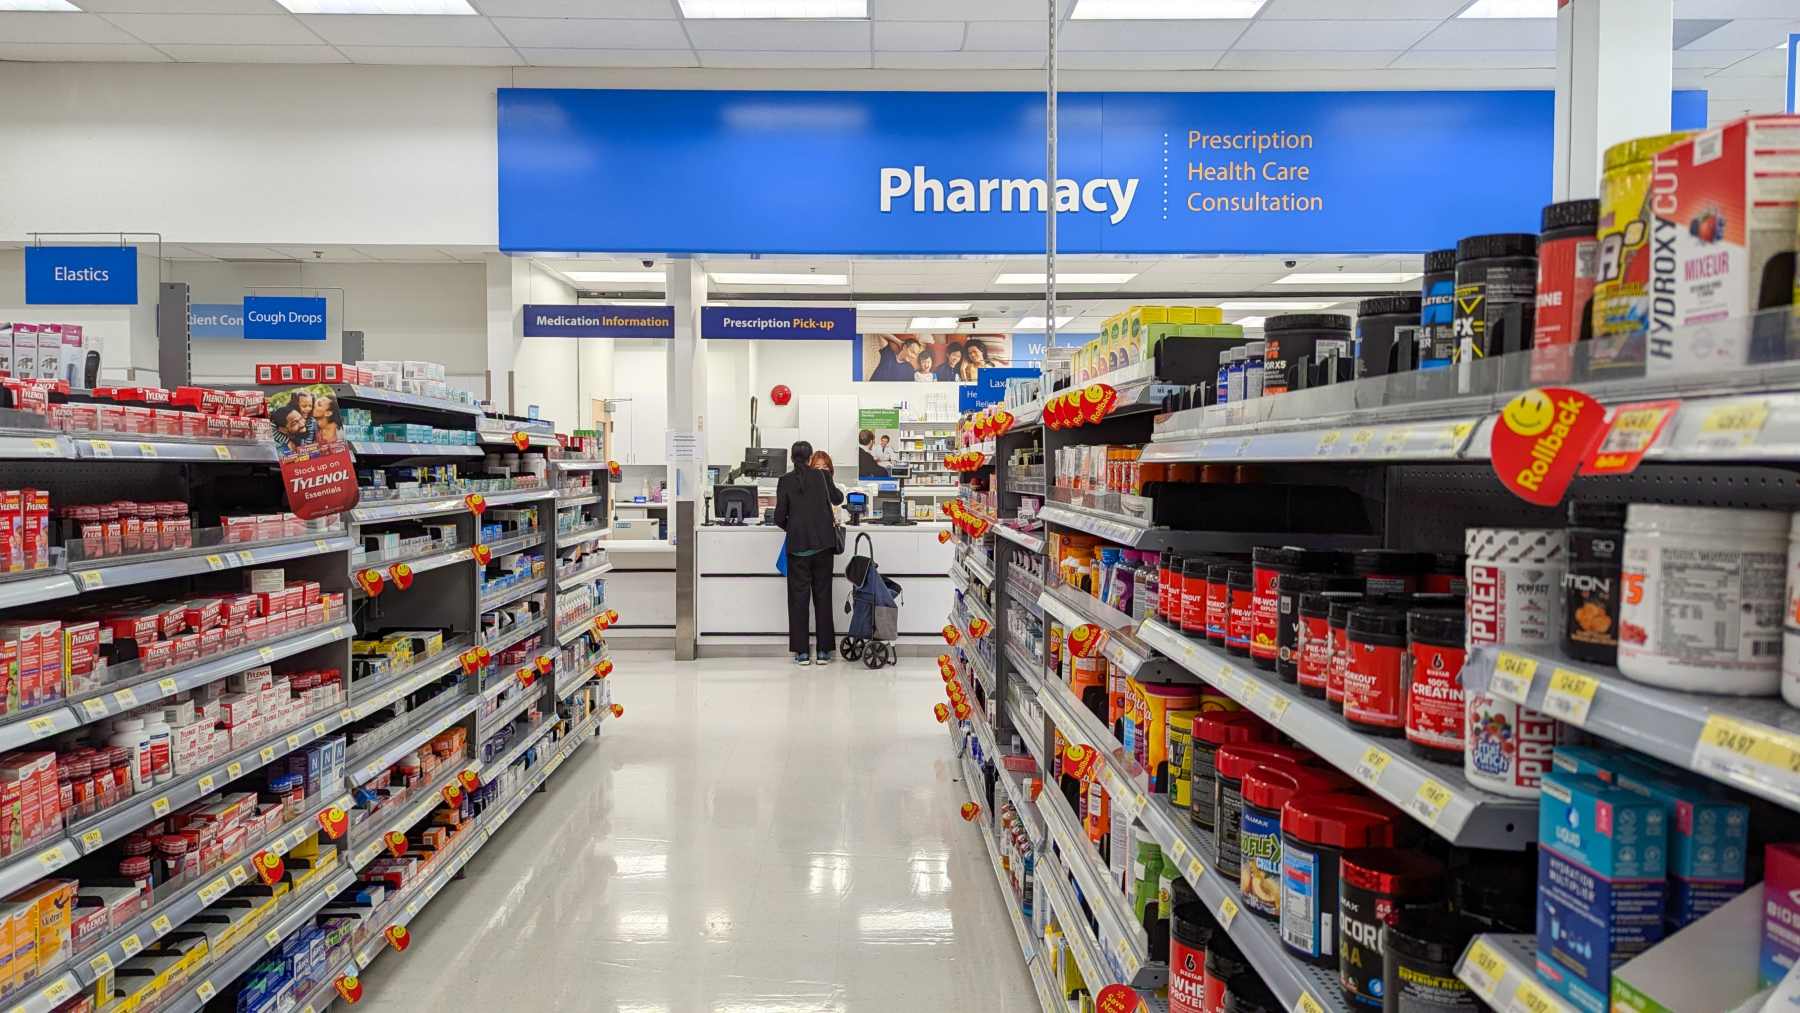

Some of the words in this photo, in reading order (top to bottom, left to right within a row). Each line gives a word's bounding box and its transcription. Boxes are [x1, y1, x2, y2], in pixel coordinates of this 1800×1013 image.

[1188, 129, 1313, 154] Prescription
[1188, 162, 1255, 182] Health
[1262, 162, 1310, 182] Care
[879, 165, 1140, 225] Pharmacy
[1187, 192, 1323, 212] Consultation
[1650, 157, 1679, 360] HYDROXYCUT
[1684, 251, 1729, 281] MIXEUR
[54, 266, 110, 282] Elastics
[248, 310, 287, 325] Cough
[288, 311, 322, 326] Drops
[536, 315, 600, 328] Medication
[602, 316, 669, 328] Information
[723, 317, 791, 332] Prescription
[793, 318, 835, 331] Pick-up
[1515, 396, 1584, 492] Rollback
[294, 465, 316, 476] Stock
[317, 463, 328, 473] up
[329, 460, 340, 468] on
[290, 469, 349, 493] TYLENOL
[304, 486, 342, 500] Essentials
